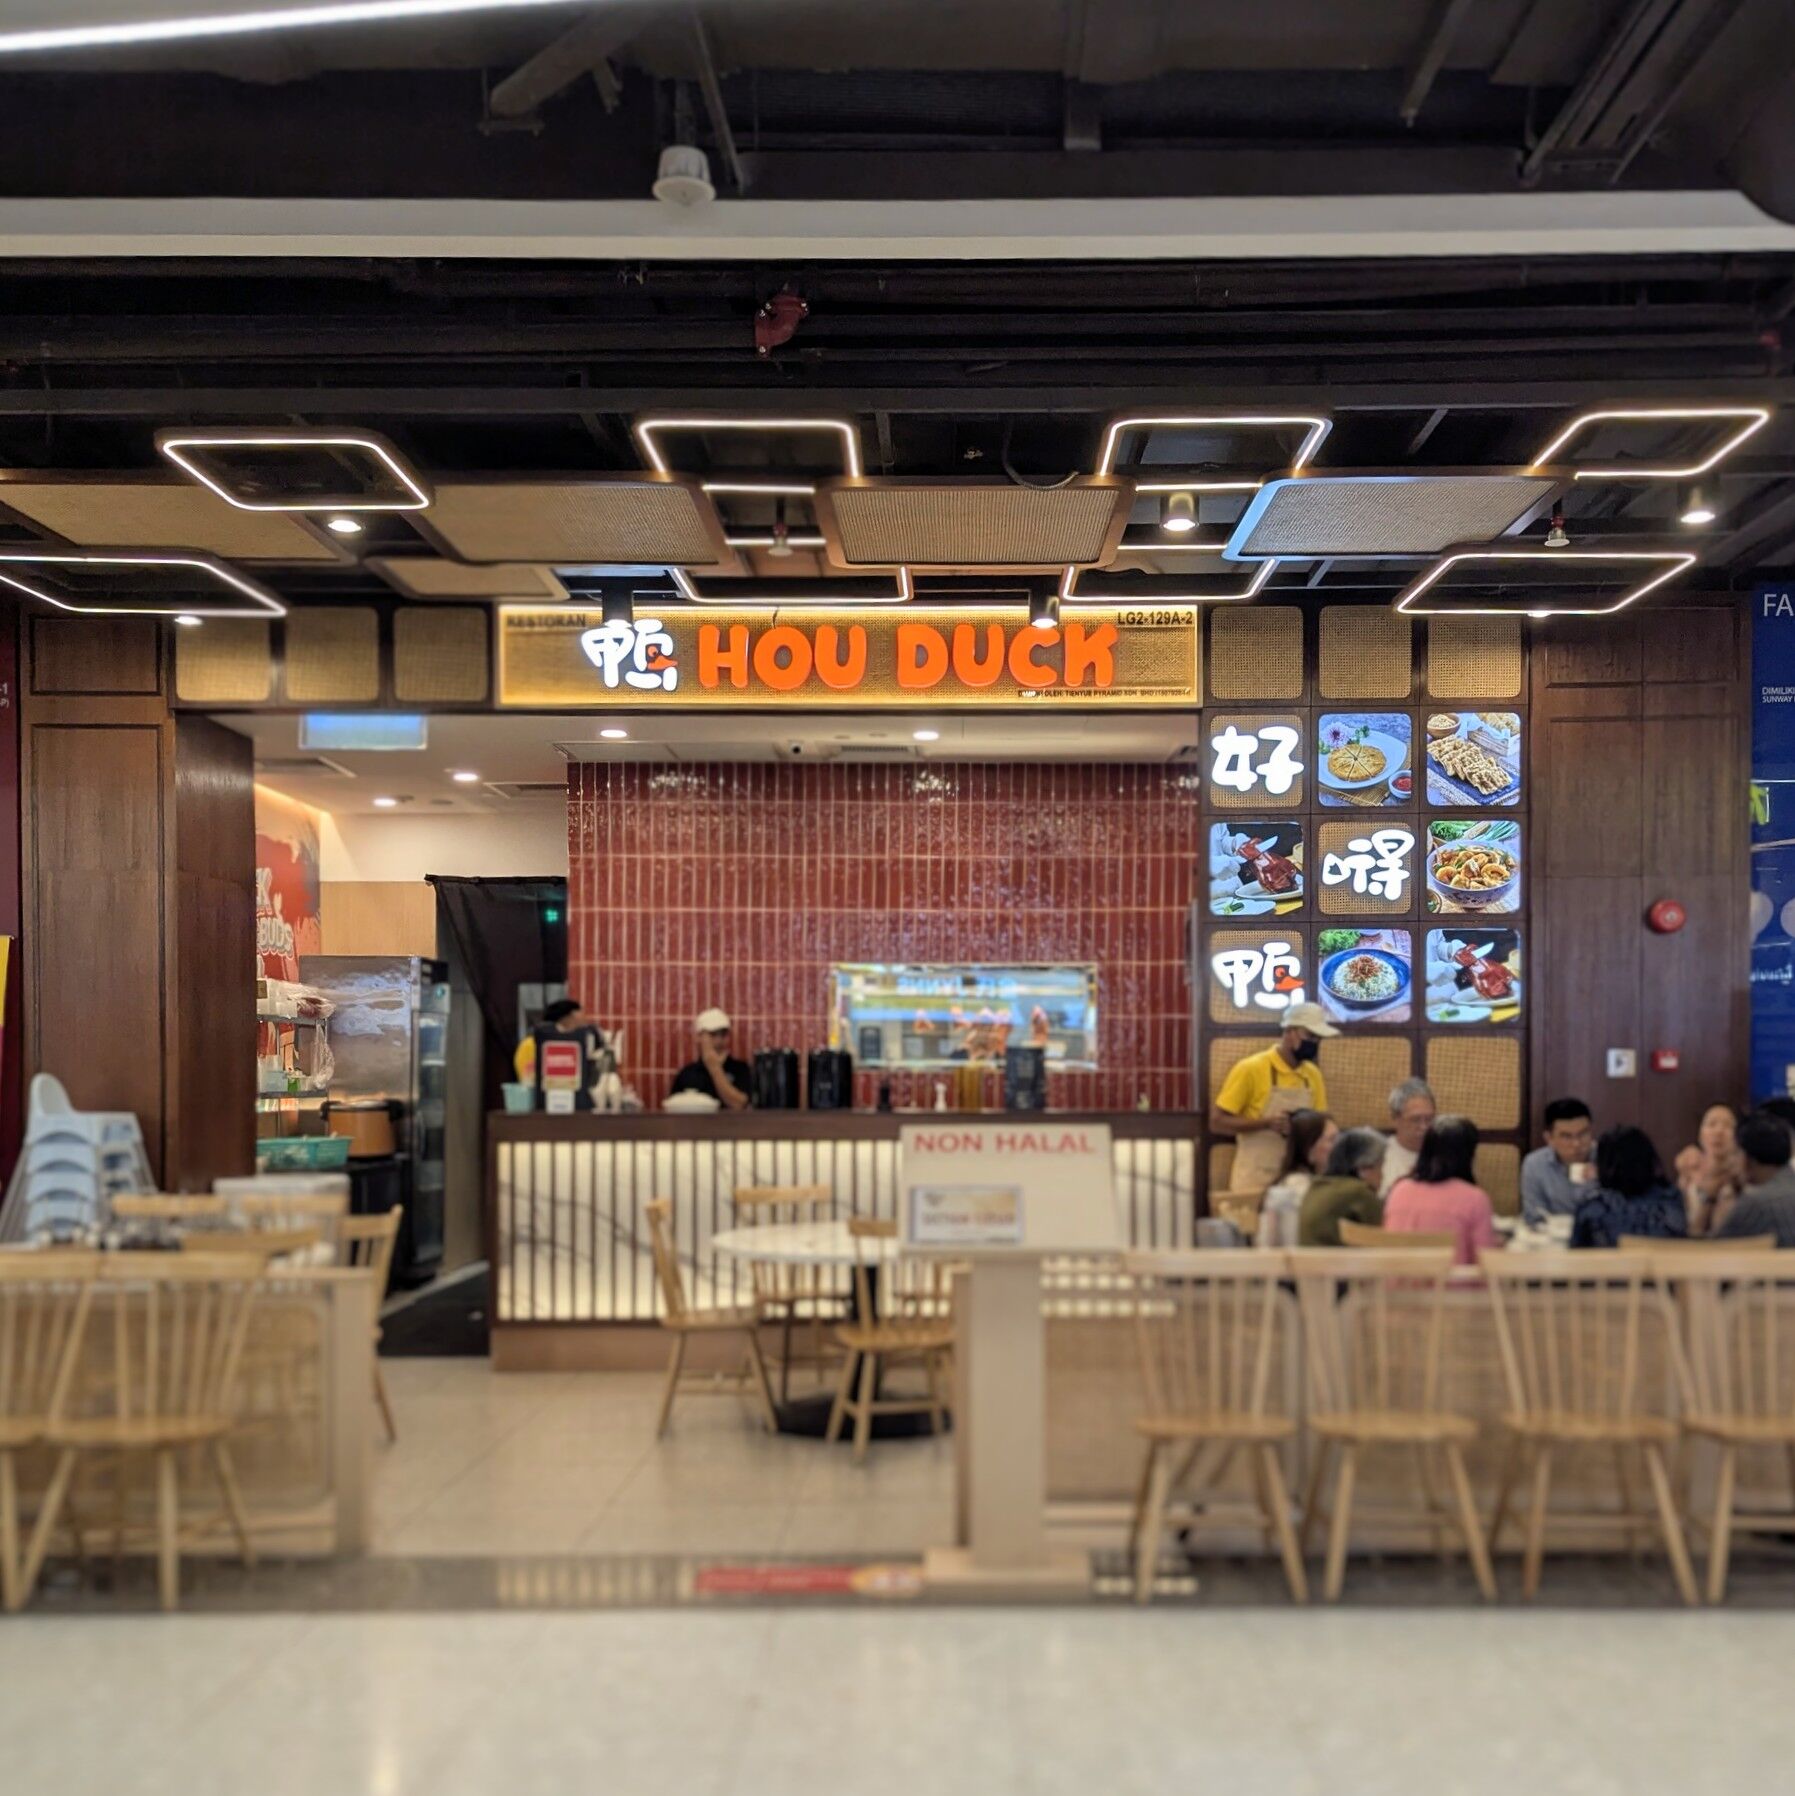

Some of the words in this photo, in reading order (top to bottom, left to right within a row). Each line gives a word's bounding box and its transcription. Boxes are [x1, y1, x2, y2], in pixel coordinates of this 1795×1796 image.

[1117, 611, 1194, 626] LG2-129A-2
[699, 624, 867, 690] HOU
[897, 623, 1119, 688] DUCK
[1762, 695, 1793, 703] SUNWAY
[1211, 725, 1304, 795] 好
[914, 1132, 983, 1153] NON
[995, 1131, 1095, 1153] HALAL
